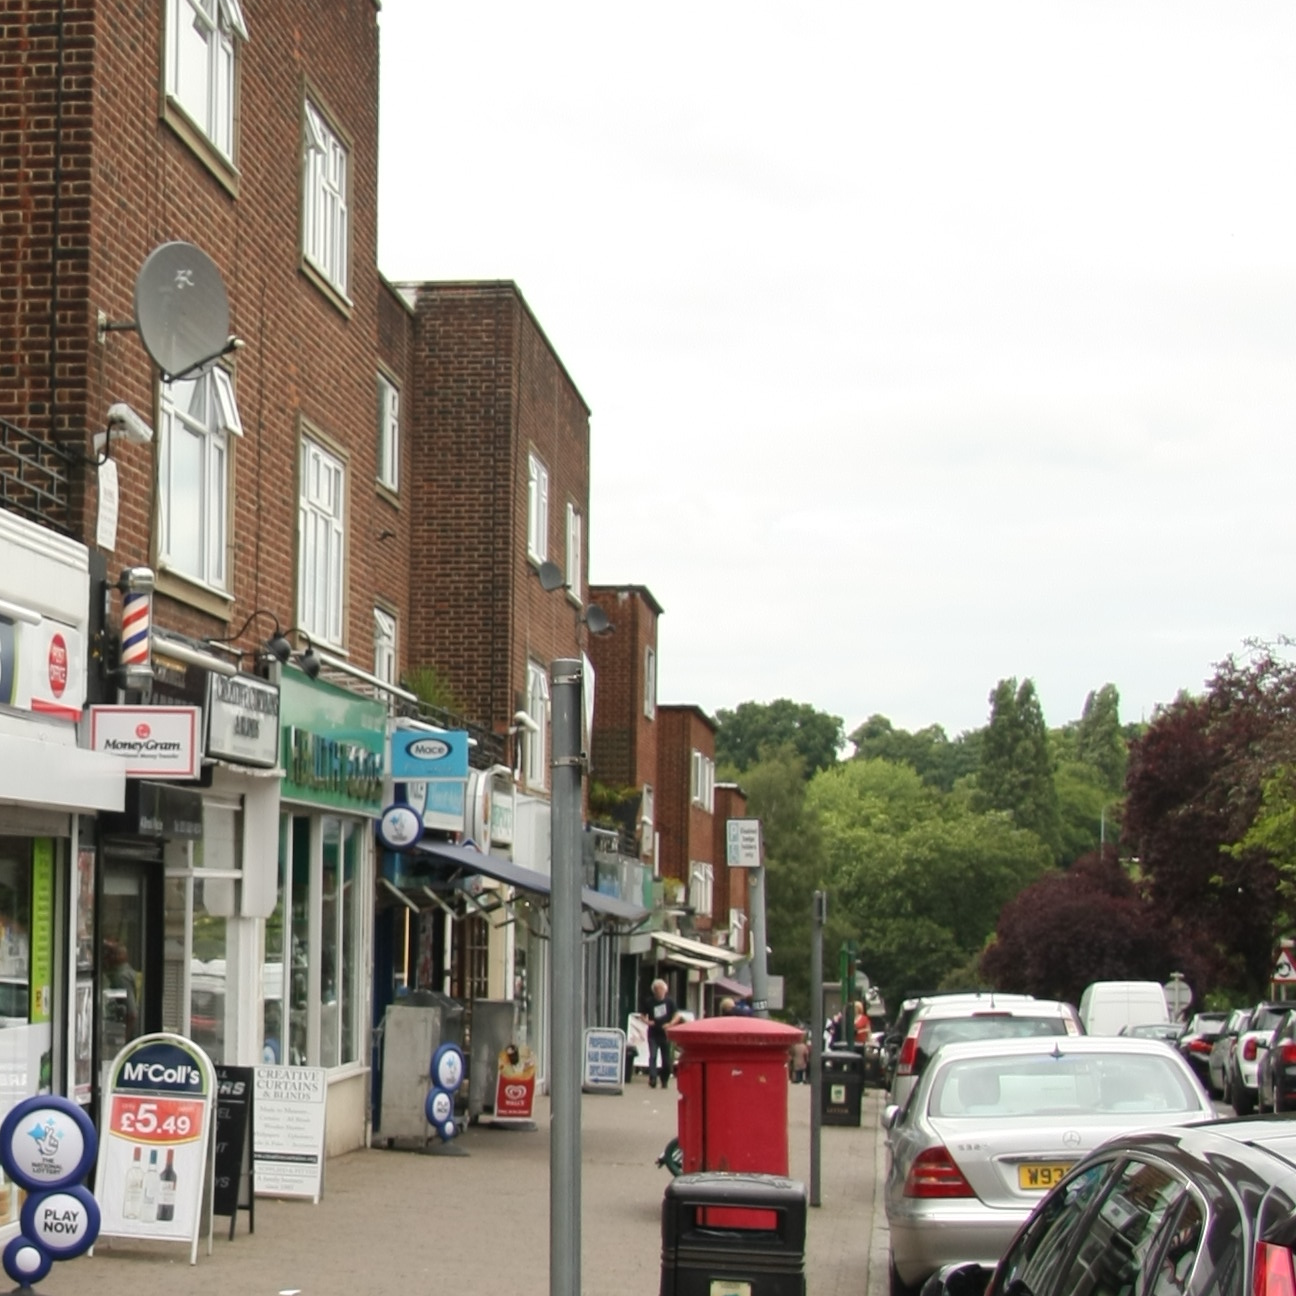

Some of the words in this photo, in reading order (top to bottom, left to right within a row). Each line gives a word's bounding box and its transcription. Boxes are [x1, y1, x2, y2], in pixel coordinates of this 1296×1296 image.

[104, 739, 181, 752] MoneyGram
[415, 744, 445, 754] Mace
[123, 1062, 200, 1085] McColl's
[257, 1068, 319, 1082] CREATIVE
[256, 1079, 319, 1092] CURTAINS
[273, 1091, 311, 1100] BLINDS
[121, 1103, 191, 1136] £5.49
[31, 1162, 63, 1170] NATIONAL
[32, 1167, 61, 1175] LOTTERY
[1028, 1167, 1069, 1185] W93
[44, 1209, 79, 1222] PLAY
[43, 1221, 78, 1234] NOW
